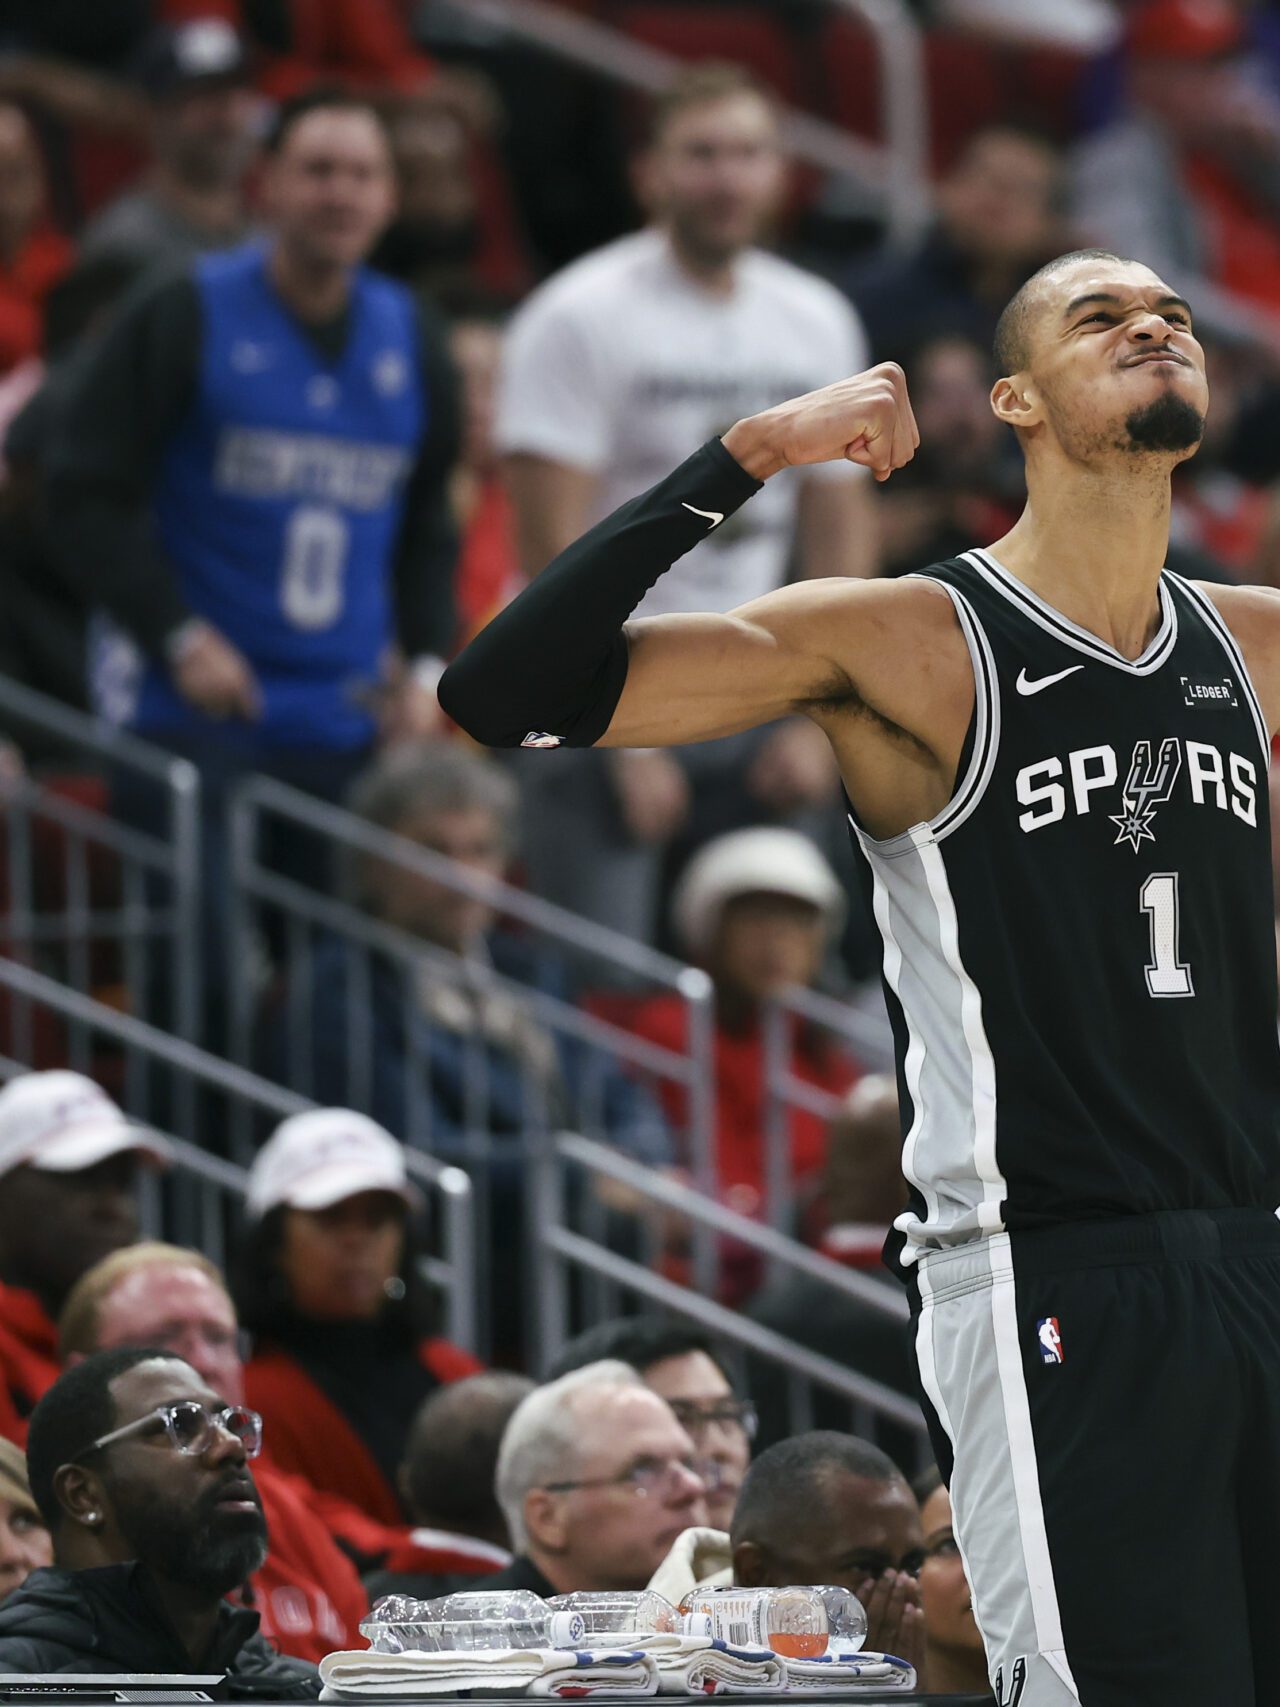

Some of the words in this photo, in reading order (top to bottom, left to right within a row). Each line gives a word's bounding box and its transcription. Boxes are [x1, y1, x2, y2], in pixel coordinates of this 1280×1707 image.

[282, 507, 348, 629] 0
[1189, 685, 1230, 699] LEDGER
[1015, 737, 1257, 855] SPURS
[1140, 872, 1195, 998] 1
